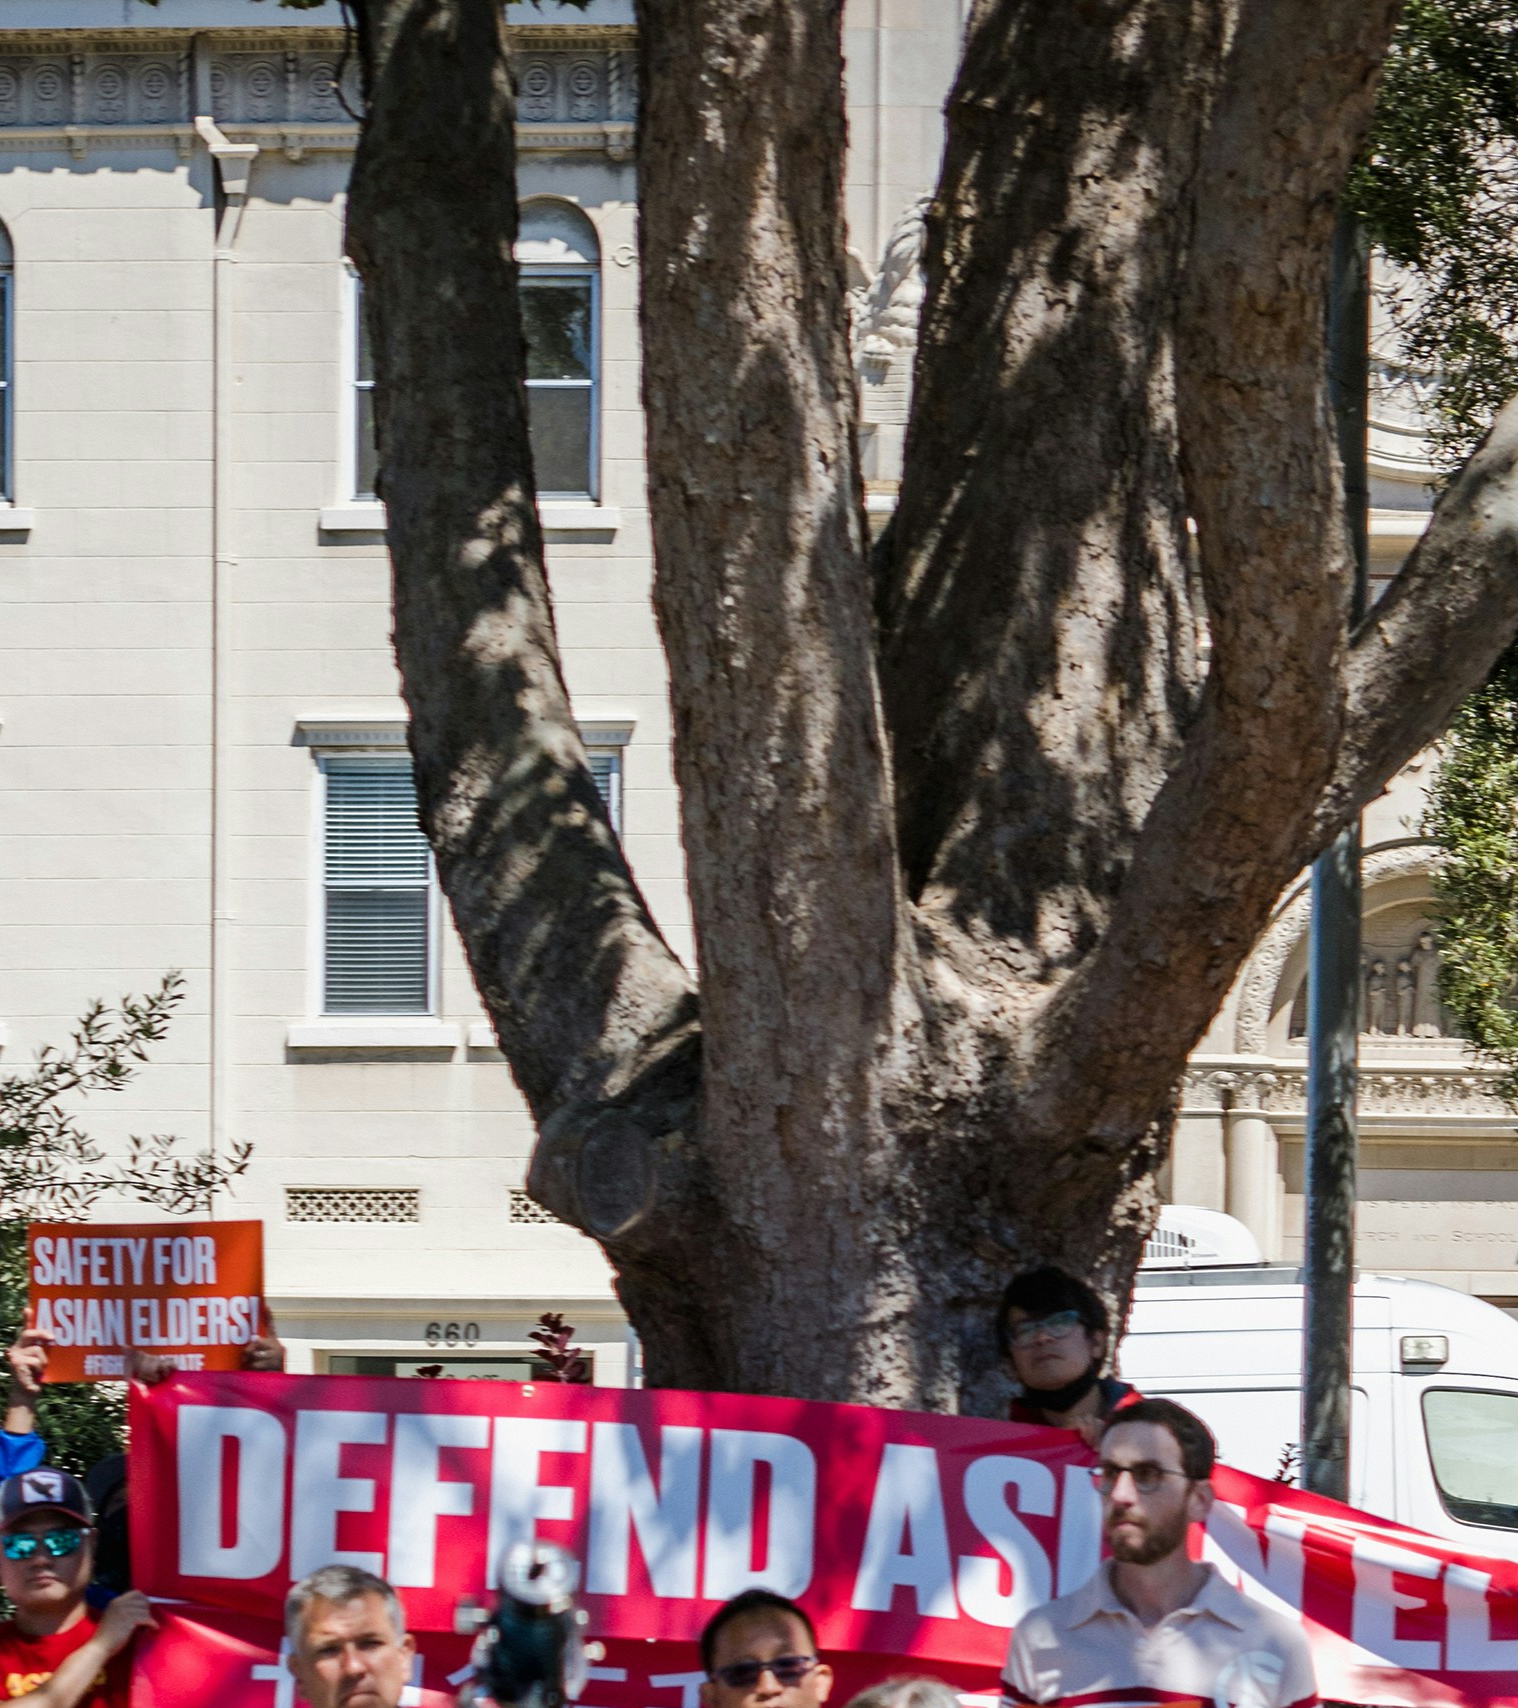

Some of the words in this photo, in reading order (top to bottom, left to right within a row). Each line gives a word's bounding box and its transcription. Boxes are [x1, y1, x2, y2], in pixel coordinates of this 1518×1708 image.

[33, 1236, 147, 1286] SAFETY
[153, 1236, 217, 1285] FOR
[35, 1297, 126, 1347] ASIAN
[131, 1296, 260, 1346] ELDERS!
[426, 1322, 481, 1348] 660
[175, 1404, 818, 1601] DEFEND
